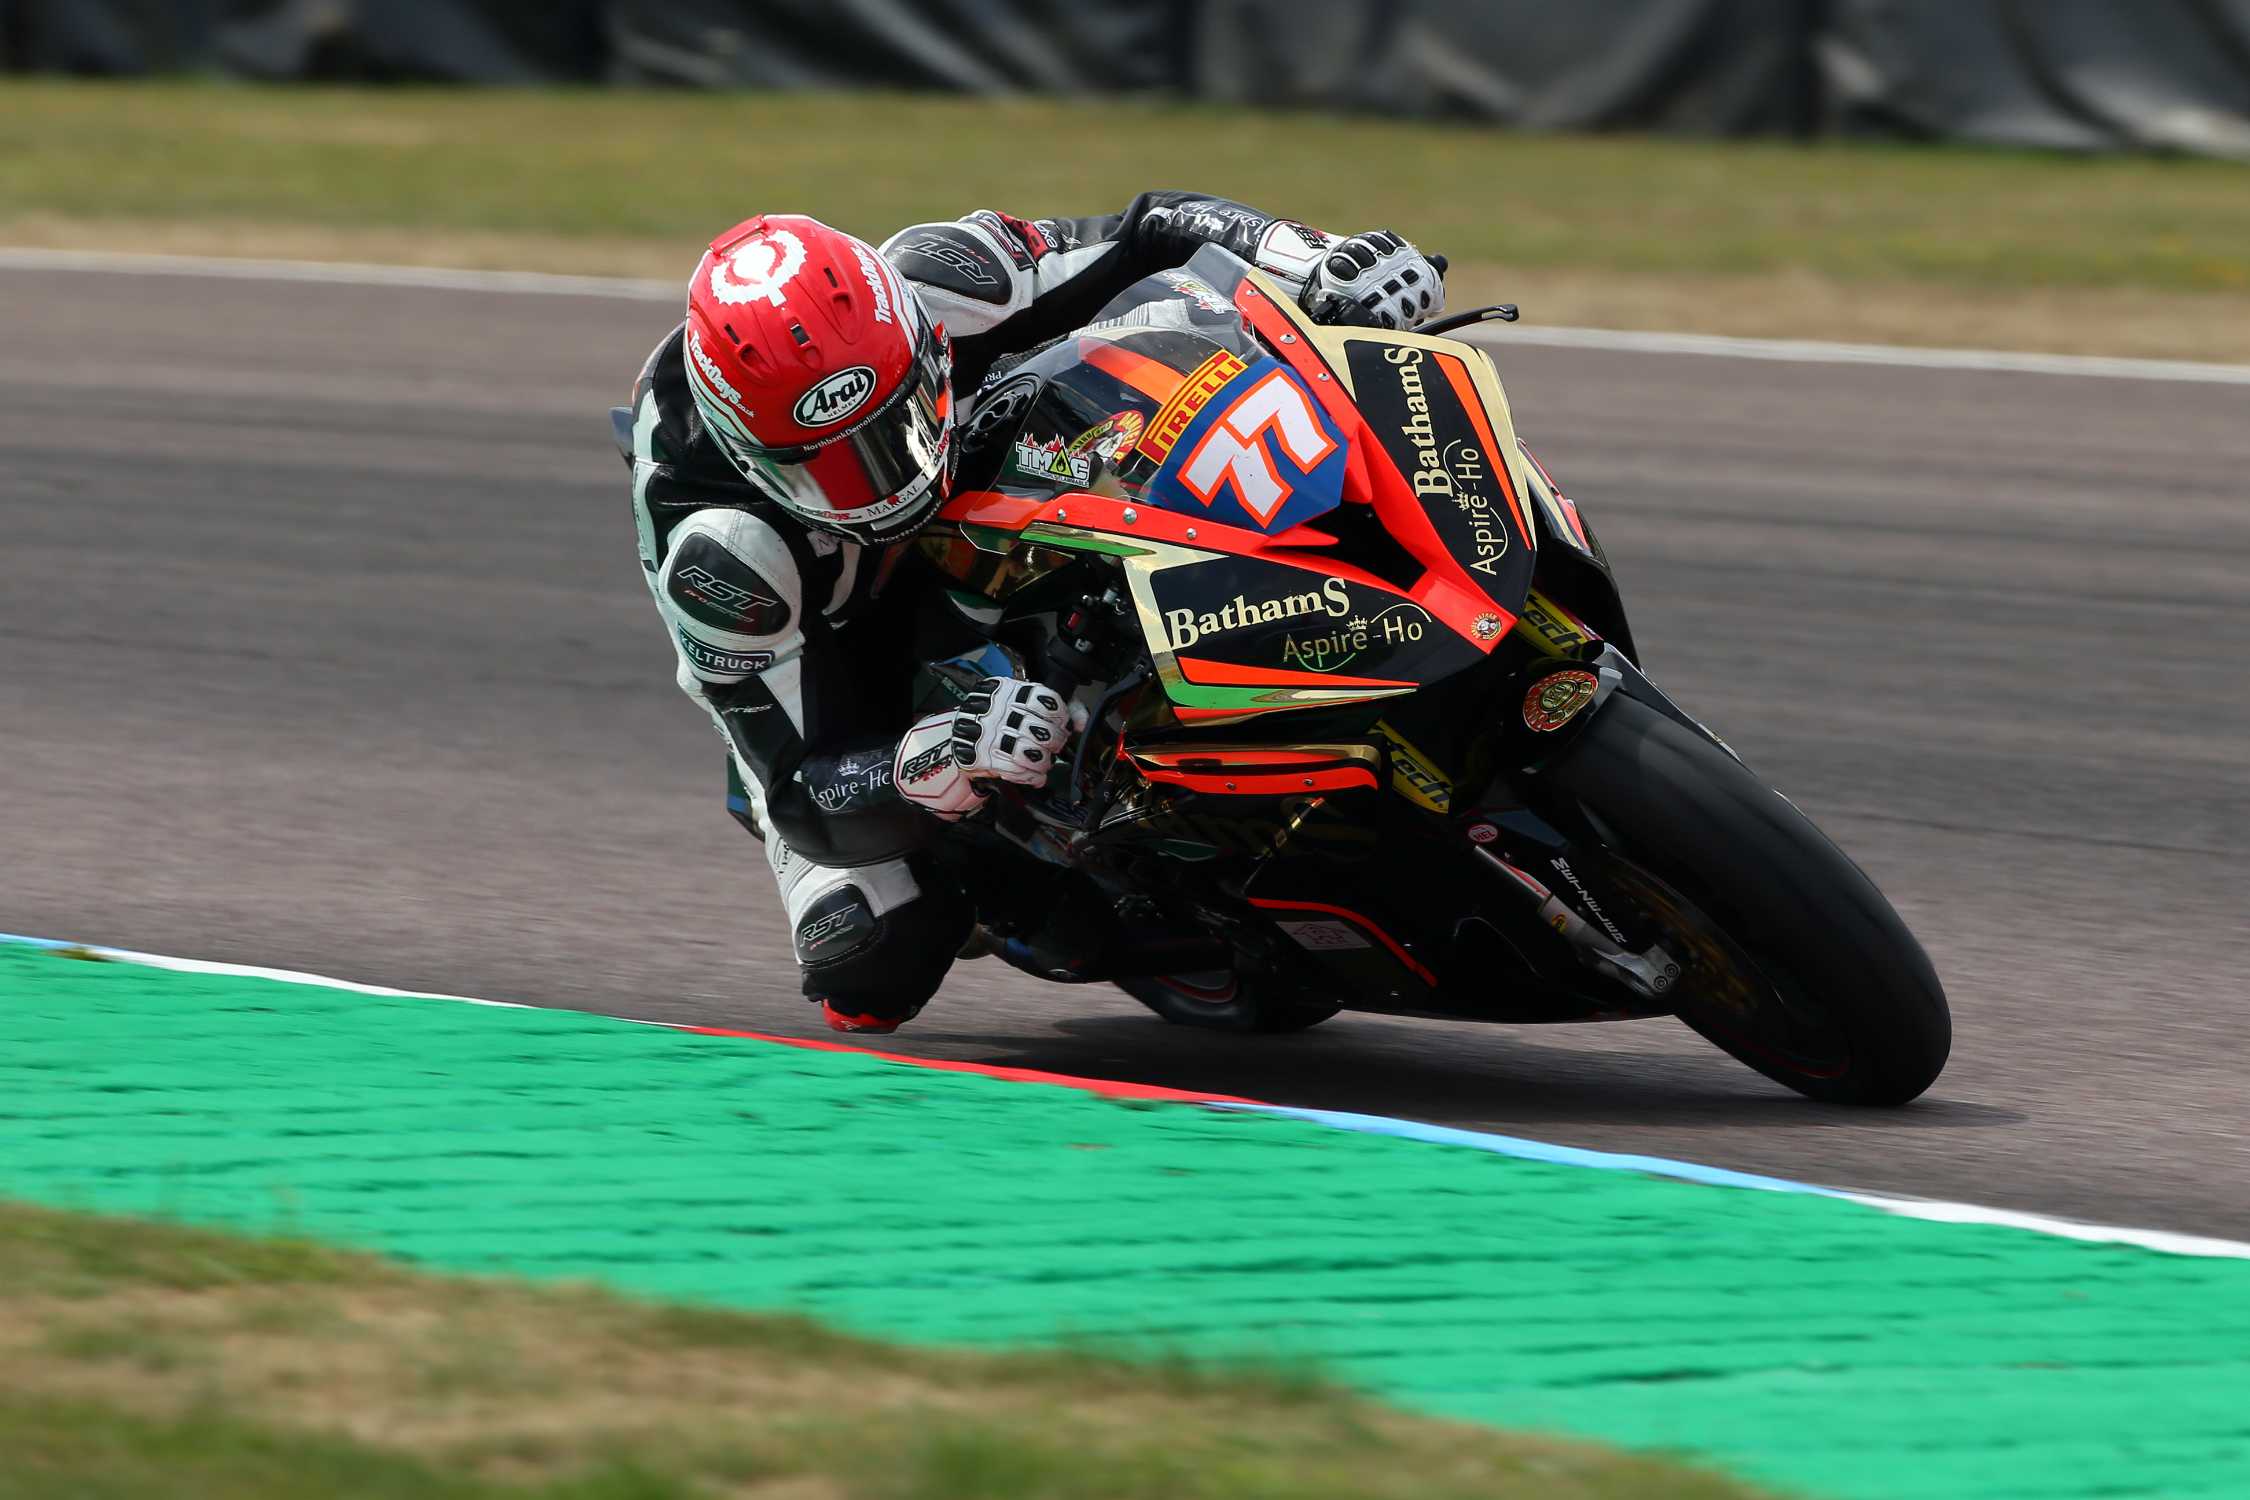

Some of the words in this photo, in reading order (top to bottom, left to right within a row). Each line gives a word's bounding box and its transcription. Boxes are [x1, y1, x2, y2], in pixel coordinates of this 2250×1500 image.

[803, 392, 900, 452] NorthbankDemolition.com
[805, 369, 866, 422] Arai
[1142, 351, 1243, 462] PIRELLI
[1384, 347, 1454, 498] BathamS
[1178, 369, 1337, 527] 77
[677, 565, 778, 610] RST
[1165, 577, 1351, 651] BathamS
[900, 738, 953, 780] RST
[800, 903, 859, 948] RST
